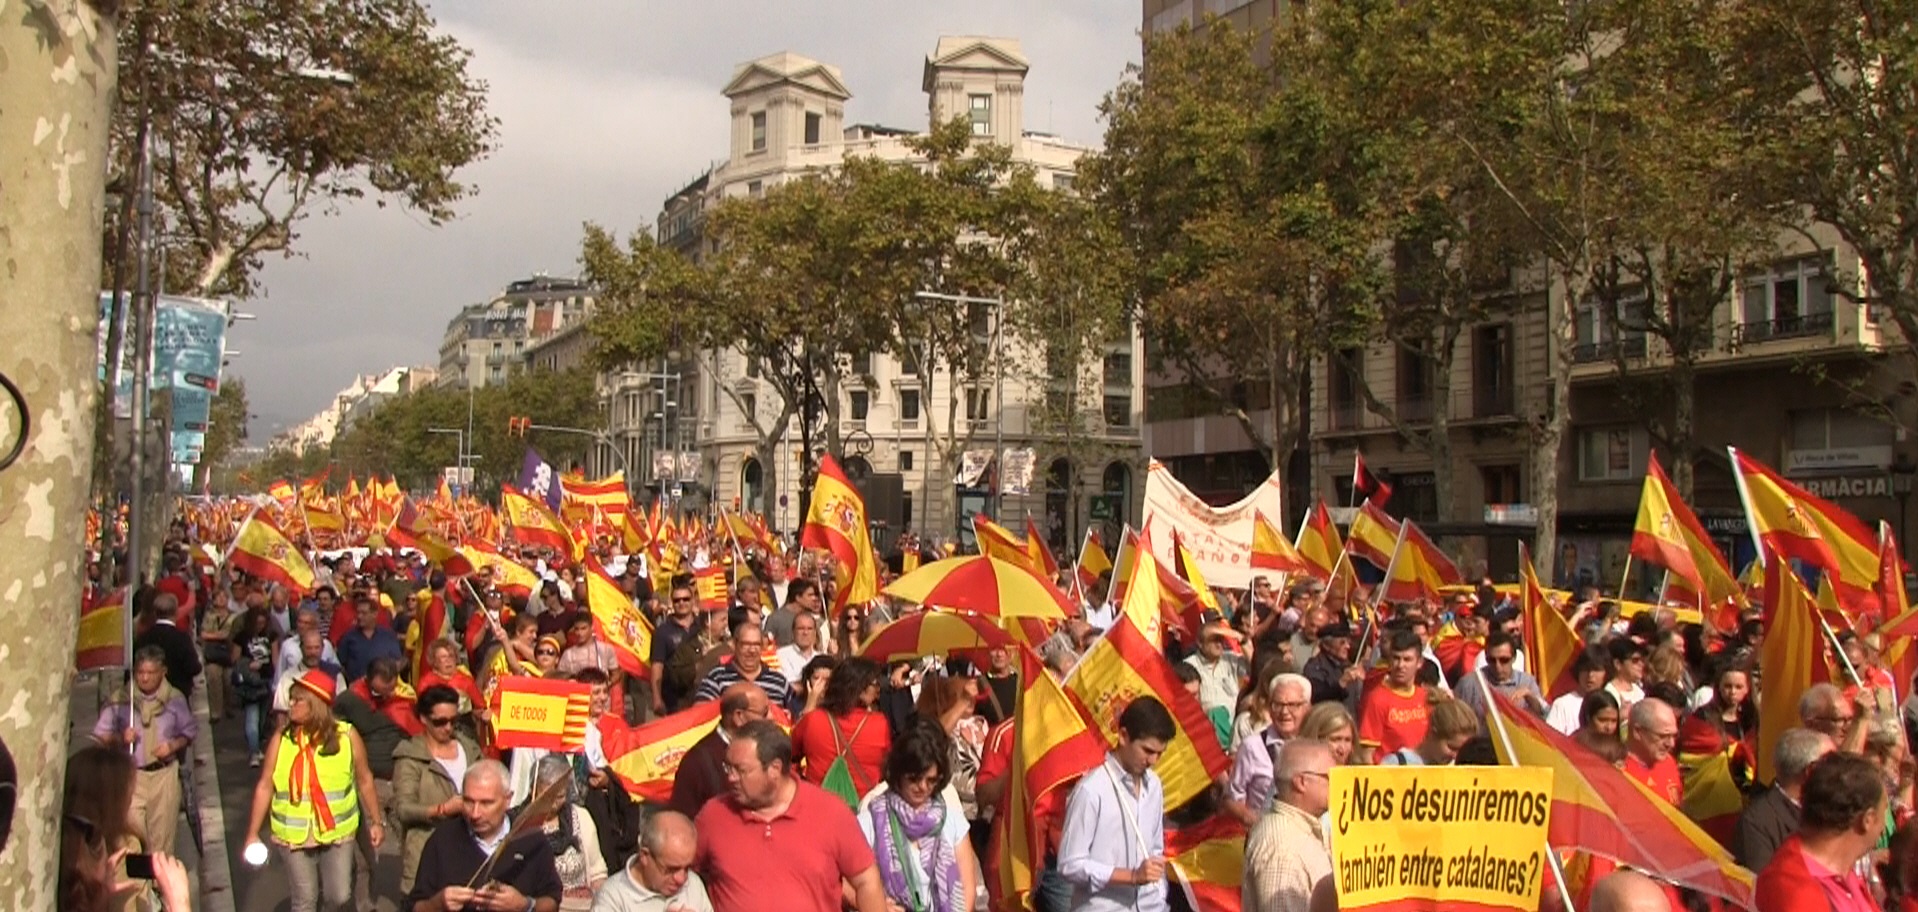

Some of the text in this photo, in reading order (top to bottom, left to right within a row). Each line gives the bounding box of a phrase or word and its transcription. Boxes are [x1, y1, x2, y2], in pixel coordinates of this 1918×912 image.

[511, 705, 547, 722] DE TODOS
[1338, 777, 1548, 836] ¿Nos desuniremos
[1340, 843, 1539, 898] también entre catalanes?
